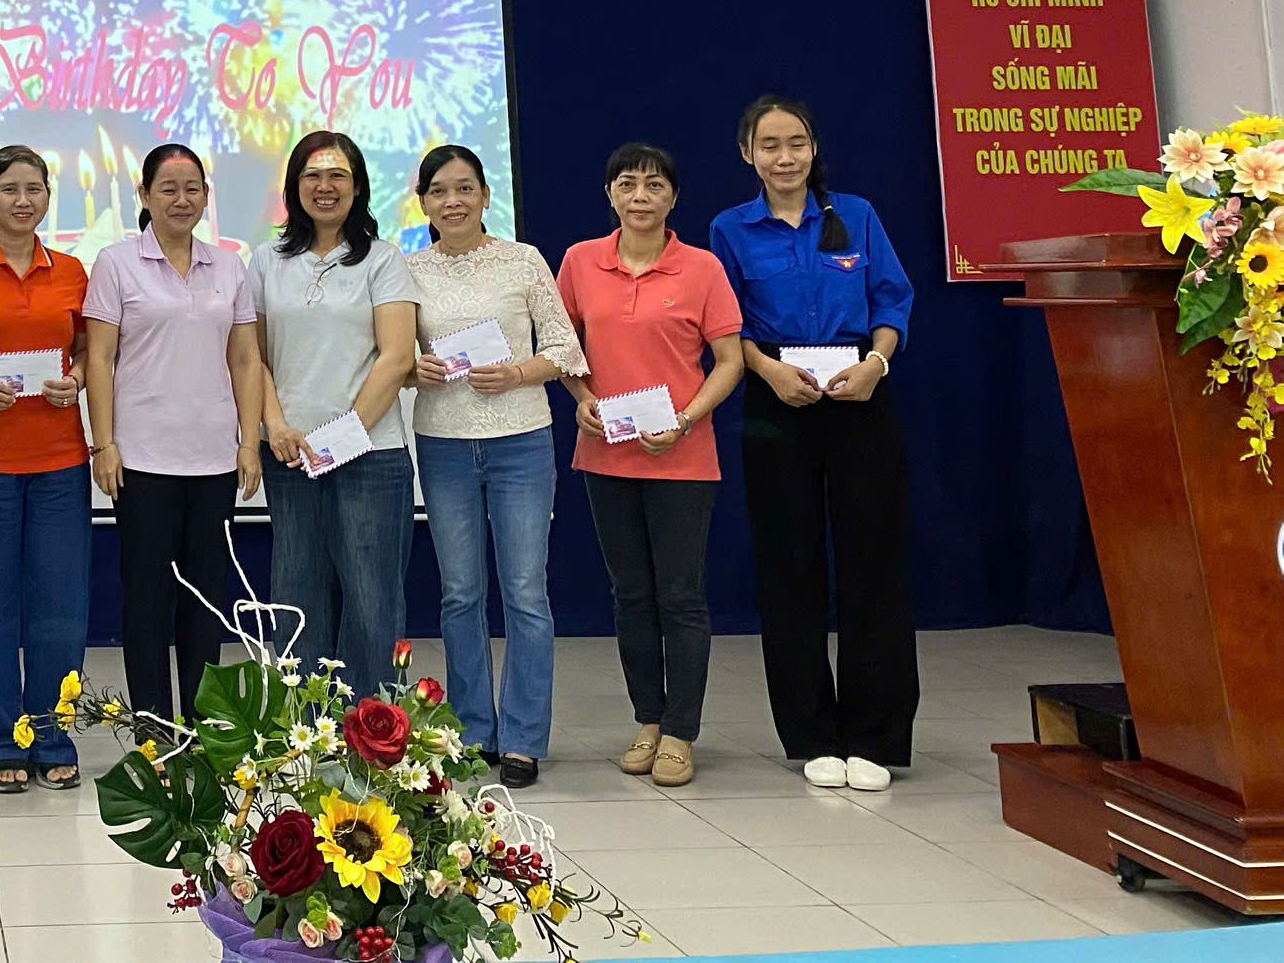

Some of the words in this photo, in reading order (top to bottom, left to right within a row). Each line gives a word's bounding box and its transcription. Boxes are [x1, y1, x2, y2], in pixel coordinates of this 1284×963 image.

[1009, 21, 1030, 48] VĨ
[1036, 25, 1072, 53] ĐẠI
[205, 22, 277, 111] To
[298, 23, 414, 132] You
[992, 58, 1050, 90] SỐNG
[1056, 61, 1097, 89] MÃI
[952, 108, 1024, 132] TRONG
[1030, 106, 1059, 136] SỰ
[1064, 102, 1142, 136] NGHIỆP
[976, 142, 1020, 173] CỦA
[1025, 144, 1099, 174] CHÚNG
[1103, 149, 1128, 169] TA
